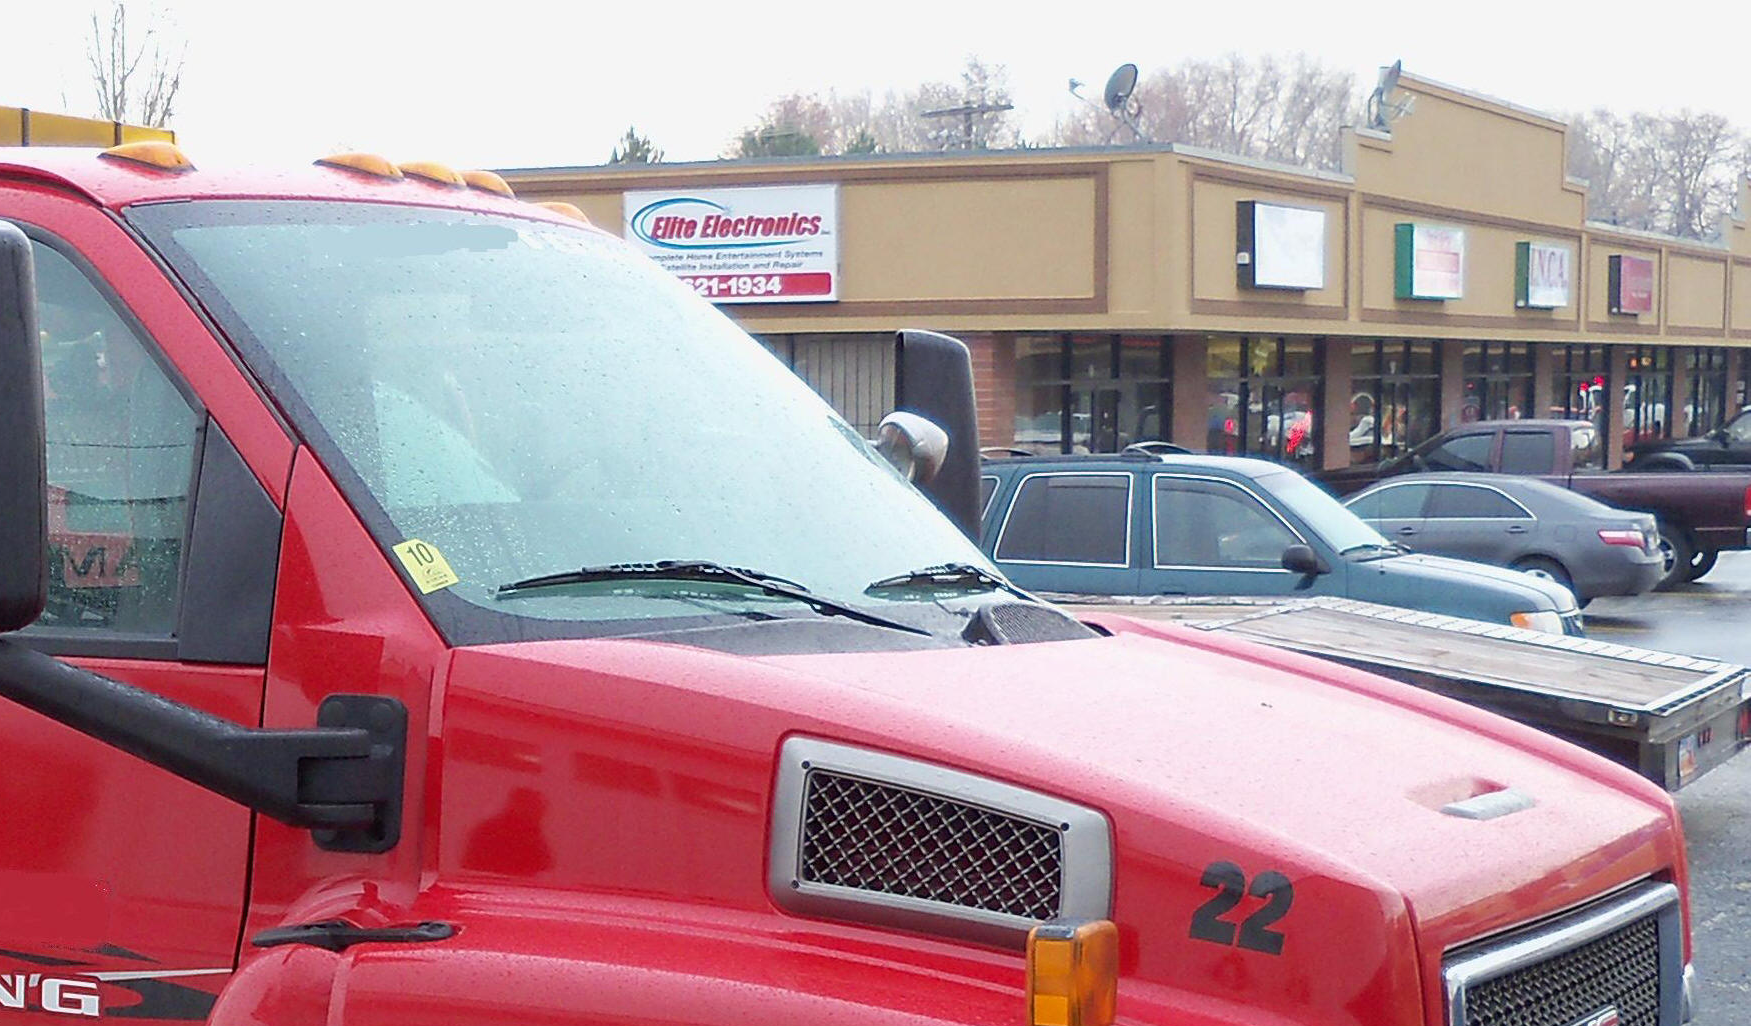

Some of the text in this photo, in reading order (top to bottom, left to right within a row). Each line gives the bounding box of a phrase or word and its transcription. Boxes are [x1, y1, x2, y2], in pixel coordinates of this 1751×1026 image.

[651, 212, 821, 240] Elite Electronics
[686, 251, 712, 261] Home
[406, 543, 435, 567] 10
[1188, 860, 1294, 957] 22
